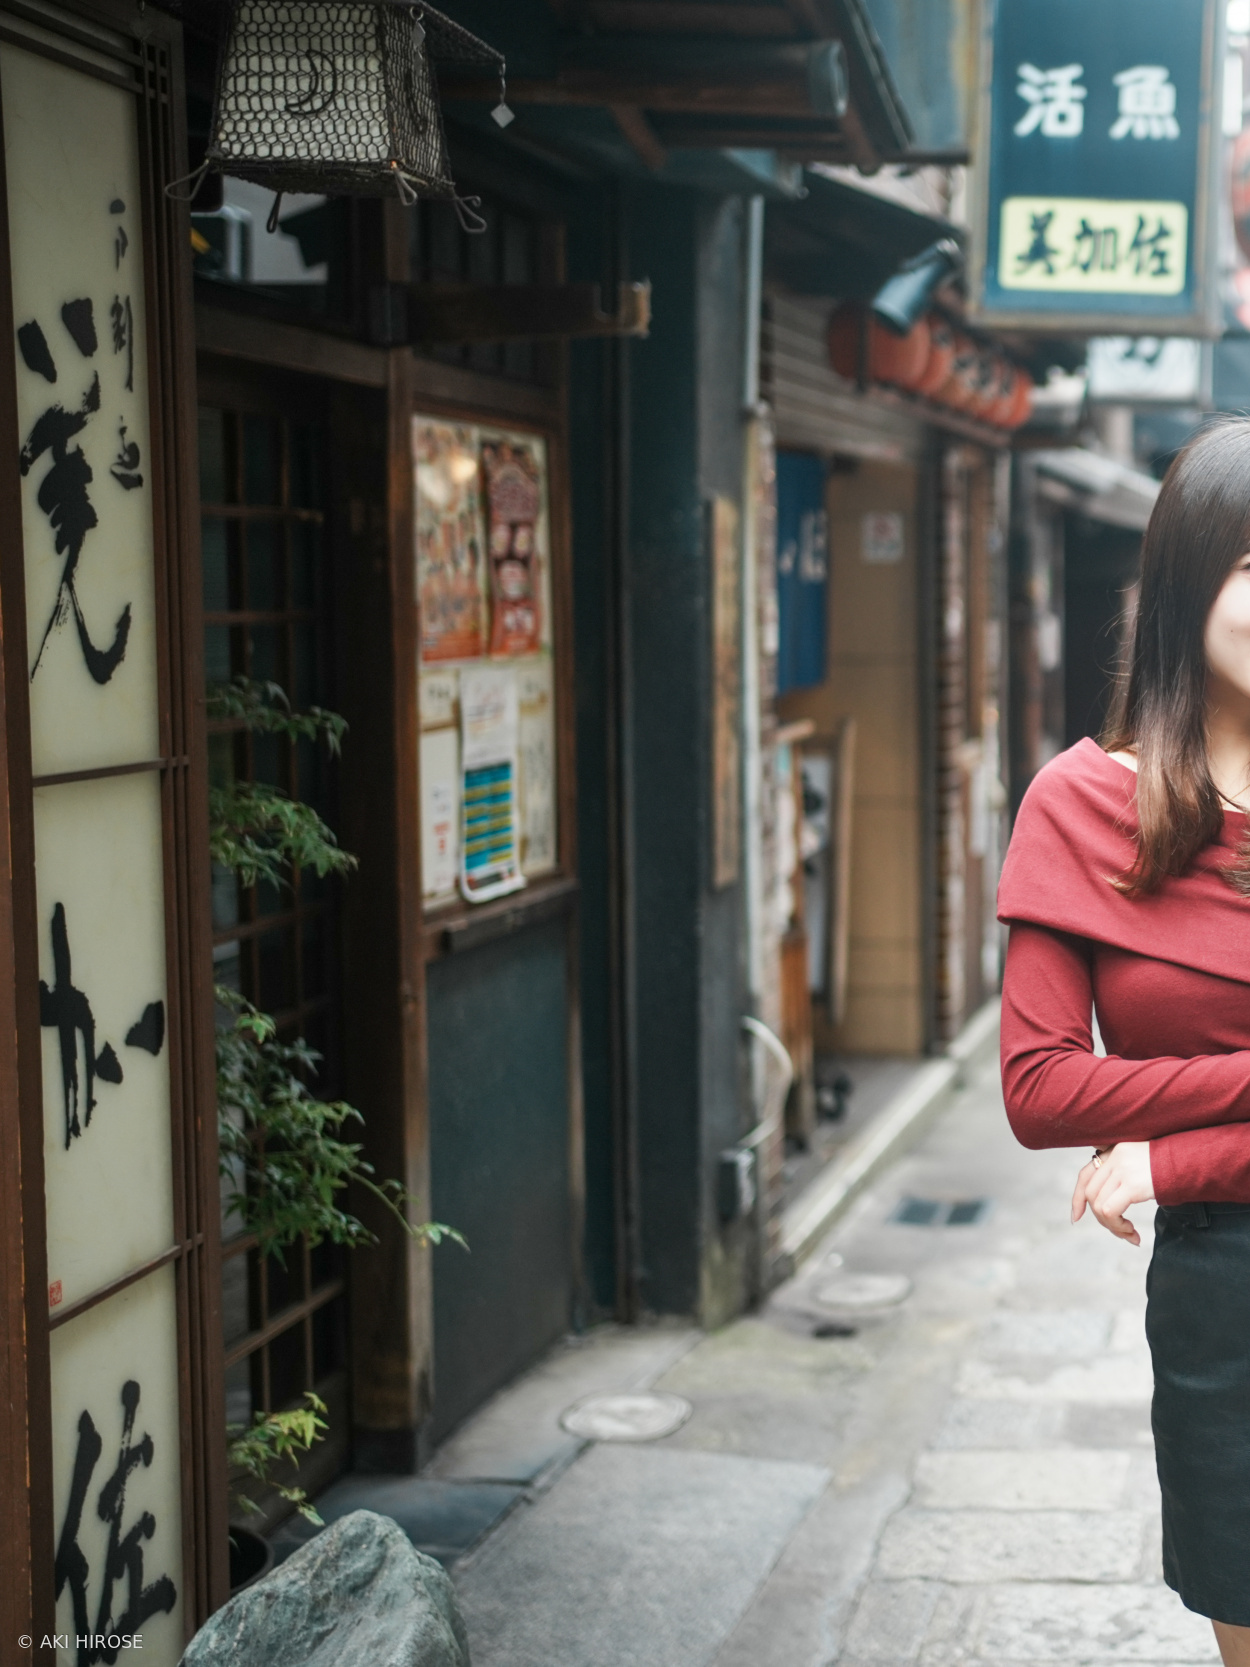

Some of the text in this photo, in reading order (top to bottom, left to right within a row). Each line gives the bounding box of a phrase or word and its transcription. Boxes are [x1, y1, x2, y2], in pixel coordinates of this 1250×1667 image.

[1014, 63, 1182, 140] 活魚
[1014, 211, 1174, 277] 美加佐
